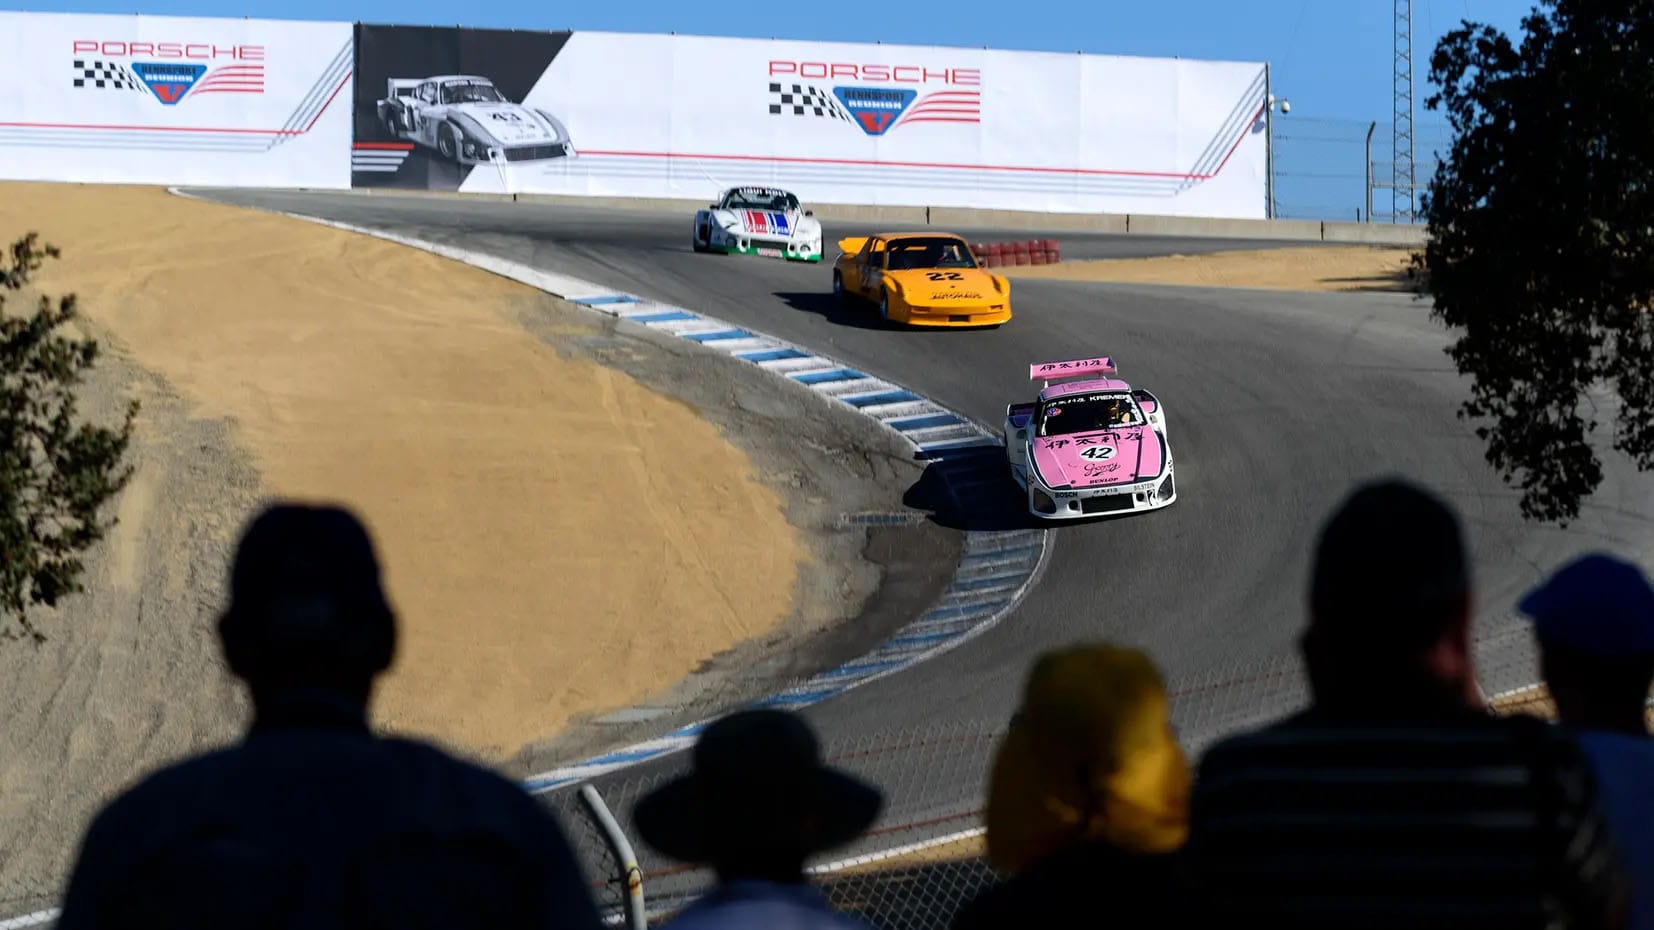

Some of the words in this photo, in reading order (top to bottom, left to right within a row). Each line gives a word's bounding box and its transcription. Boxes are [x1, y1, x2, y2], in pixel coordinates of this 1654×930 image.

[73, 40, 264, 60] PORSCHE
[769, 61, 981, 85] PORSCHE
[925, 272, 964, 281] 22
[1081, 447, 1112, 459] 42
[1055, 491, 1078, 499] BOSCH
